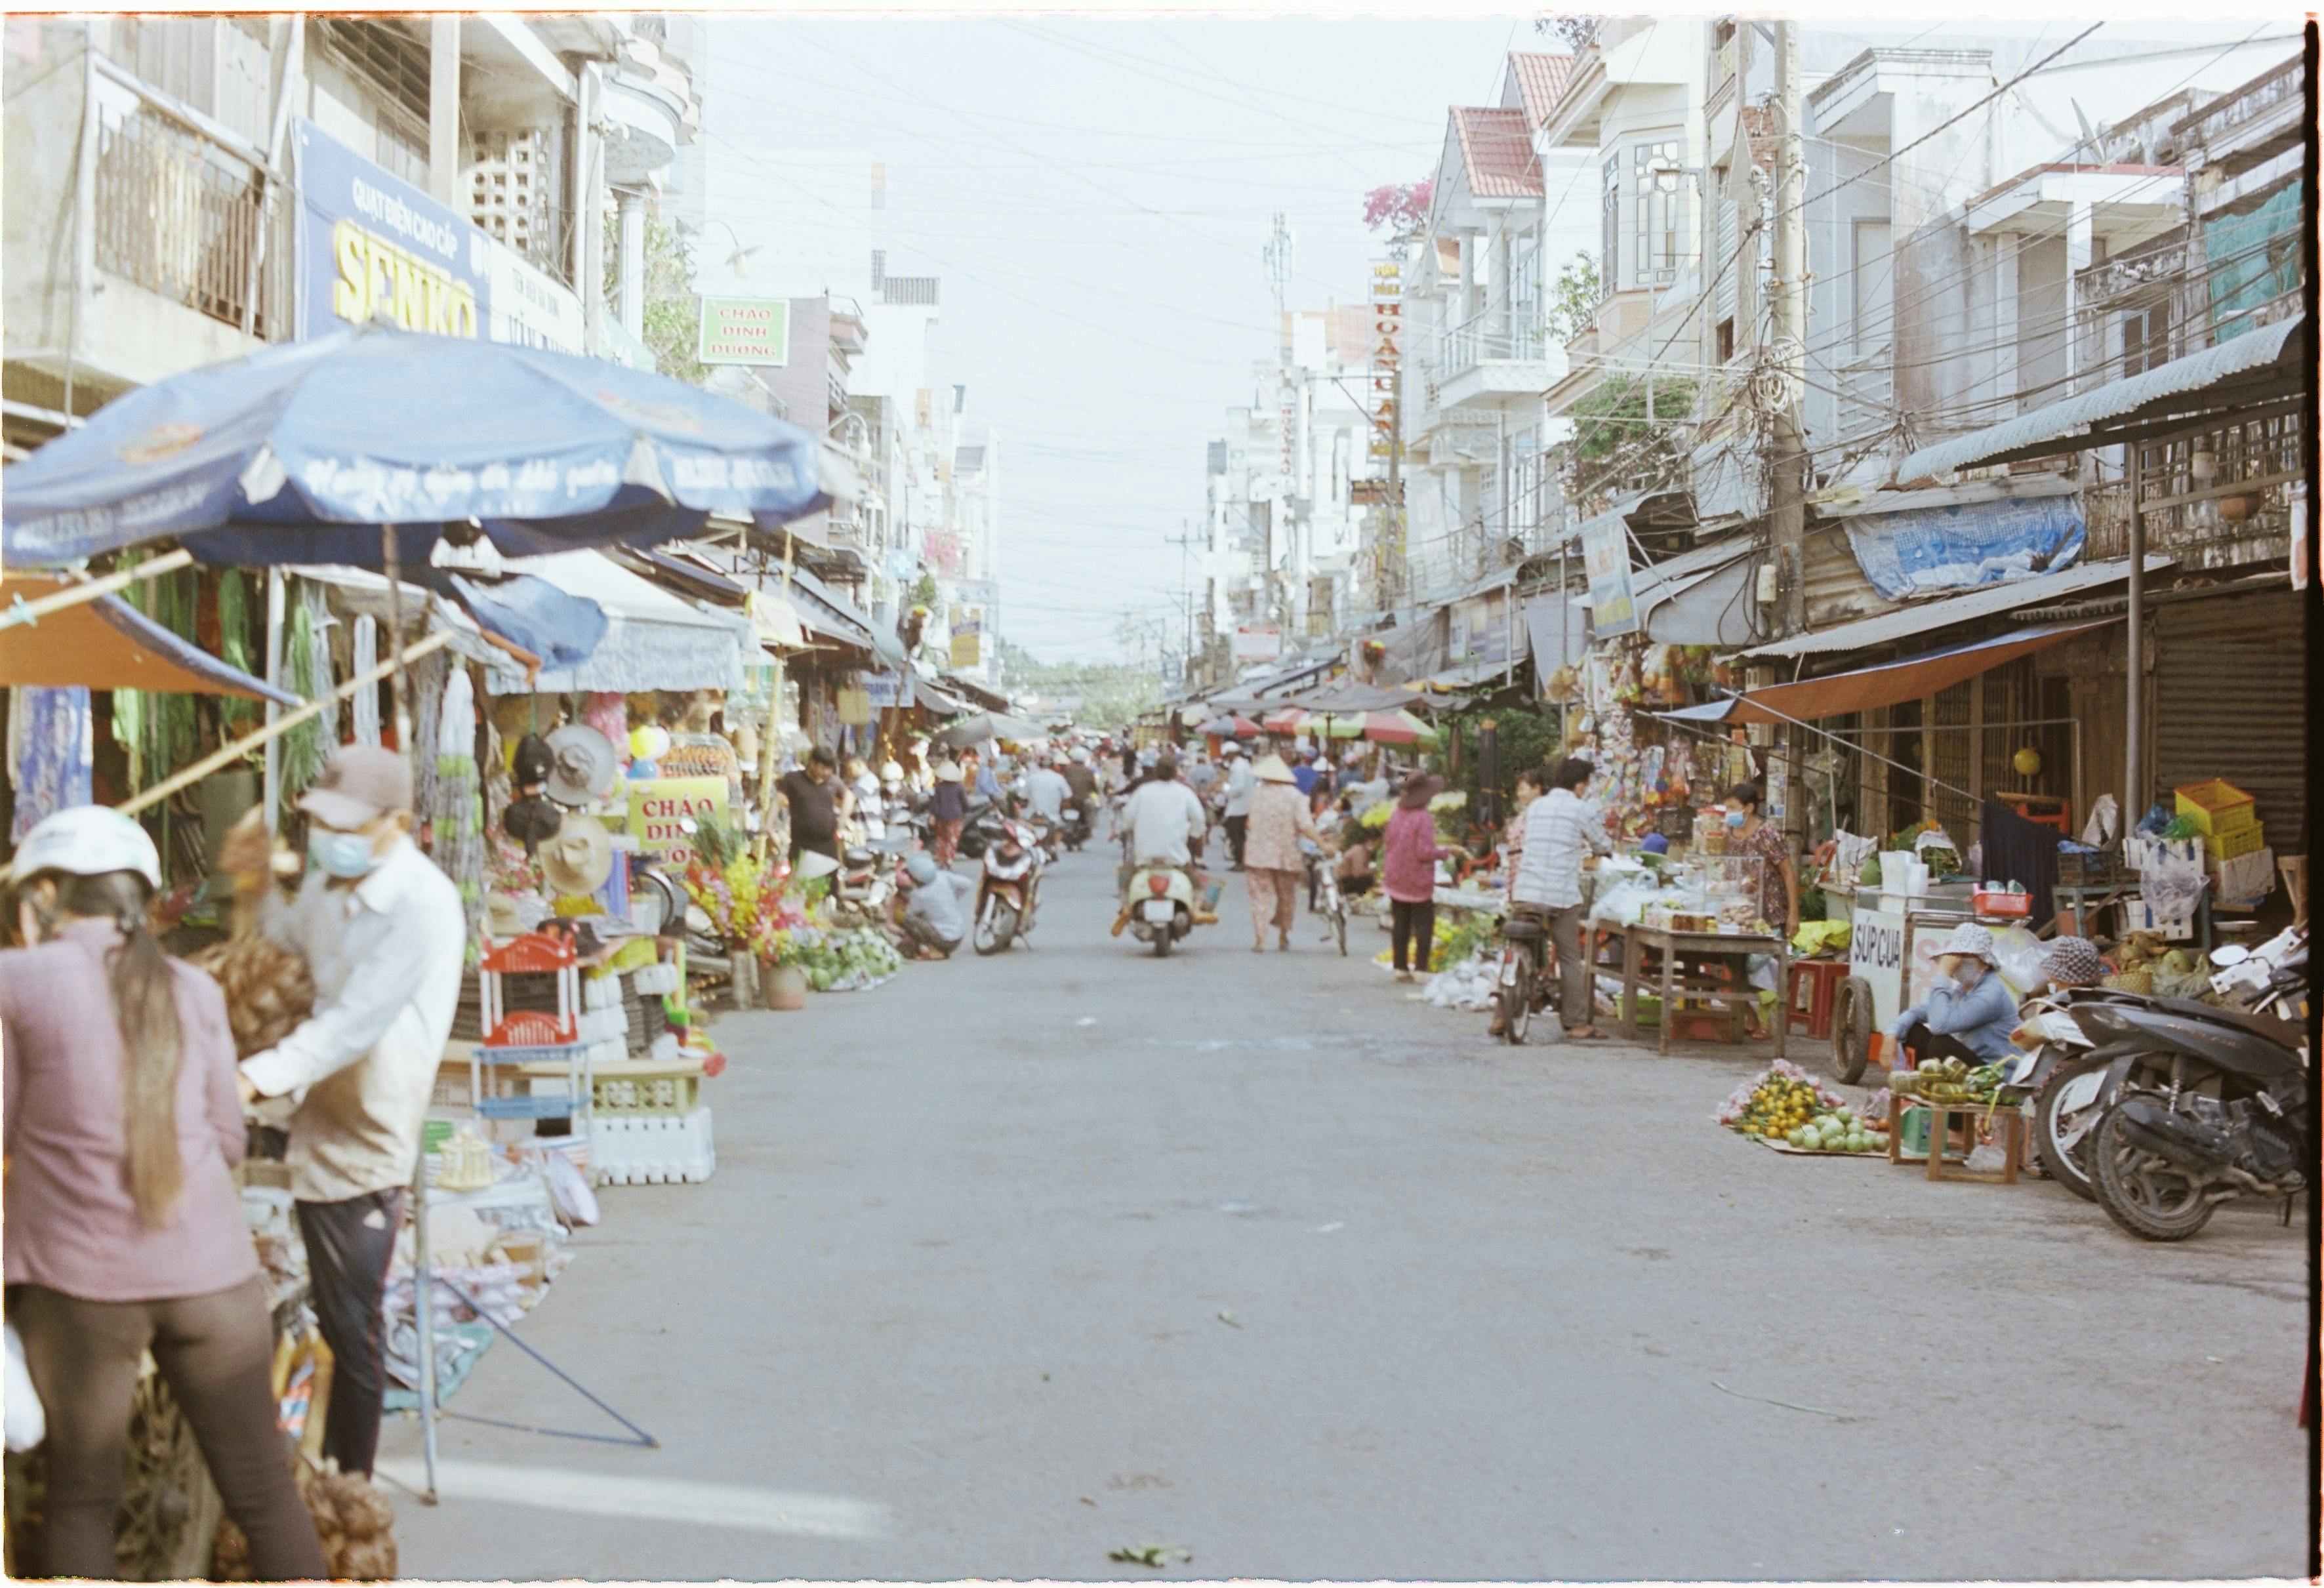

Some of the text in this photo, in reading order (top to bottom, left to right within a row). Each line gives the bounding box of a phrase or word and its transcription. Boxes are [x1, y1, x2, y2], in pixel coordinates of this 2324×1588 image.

[413, 211, 436, 249] CAO
[333, 218, 477, 340] SENKO
[723, 326, 767, 337] DINH
[1877, 927, 1901, 970] CUA
